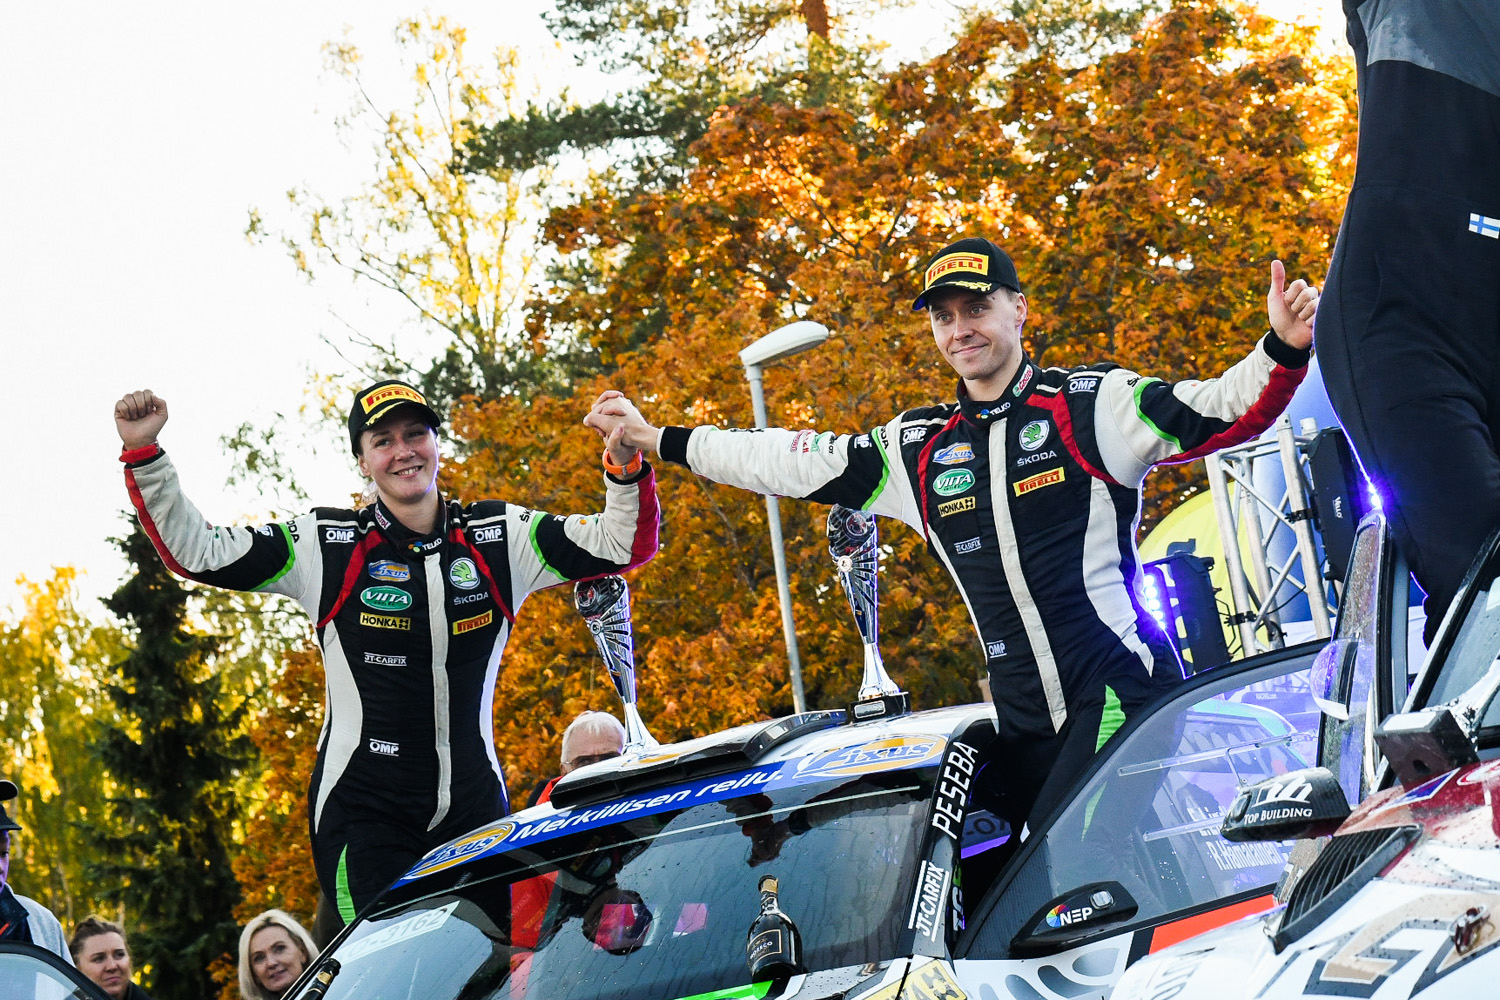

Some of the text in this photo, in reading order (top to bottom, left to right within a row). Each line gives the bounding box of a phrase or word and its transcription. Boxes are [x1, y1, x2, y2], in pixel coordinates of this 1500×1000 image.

[927, 255, 983, 284] PIRELLI
[1069, 379, 1098, 392] OMP
[902, 429, 926, 443] OMP
[1017, 450, 1058, 467] ŠKODA
[936, 473, 972, 490] VIITA
[1019, 470, 1061, 492] PIRELLI
[939, 501, 965, 516] HONKA
[325, 530, 355, 542] OMP
[474, 528, 503, 541] OMP
[366, 590, 409, 605] VIITA
[453, 591, 489, 606] ŠKODA
[361, 614, 398, 628] HONKA
[988, 642, 1006, 656] OMP
[369, 741, 400, 755] OMP
[931, 740, 979, 840] PESEBA
[508, 788, 693, 843] Merkillisen
[1243, 812, 1260, 826] TOP
[1260, 807, 1313, 822] BUILDING
